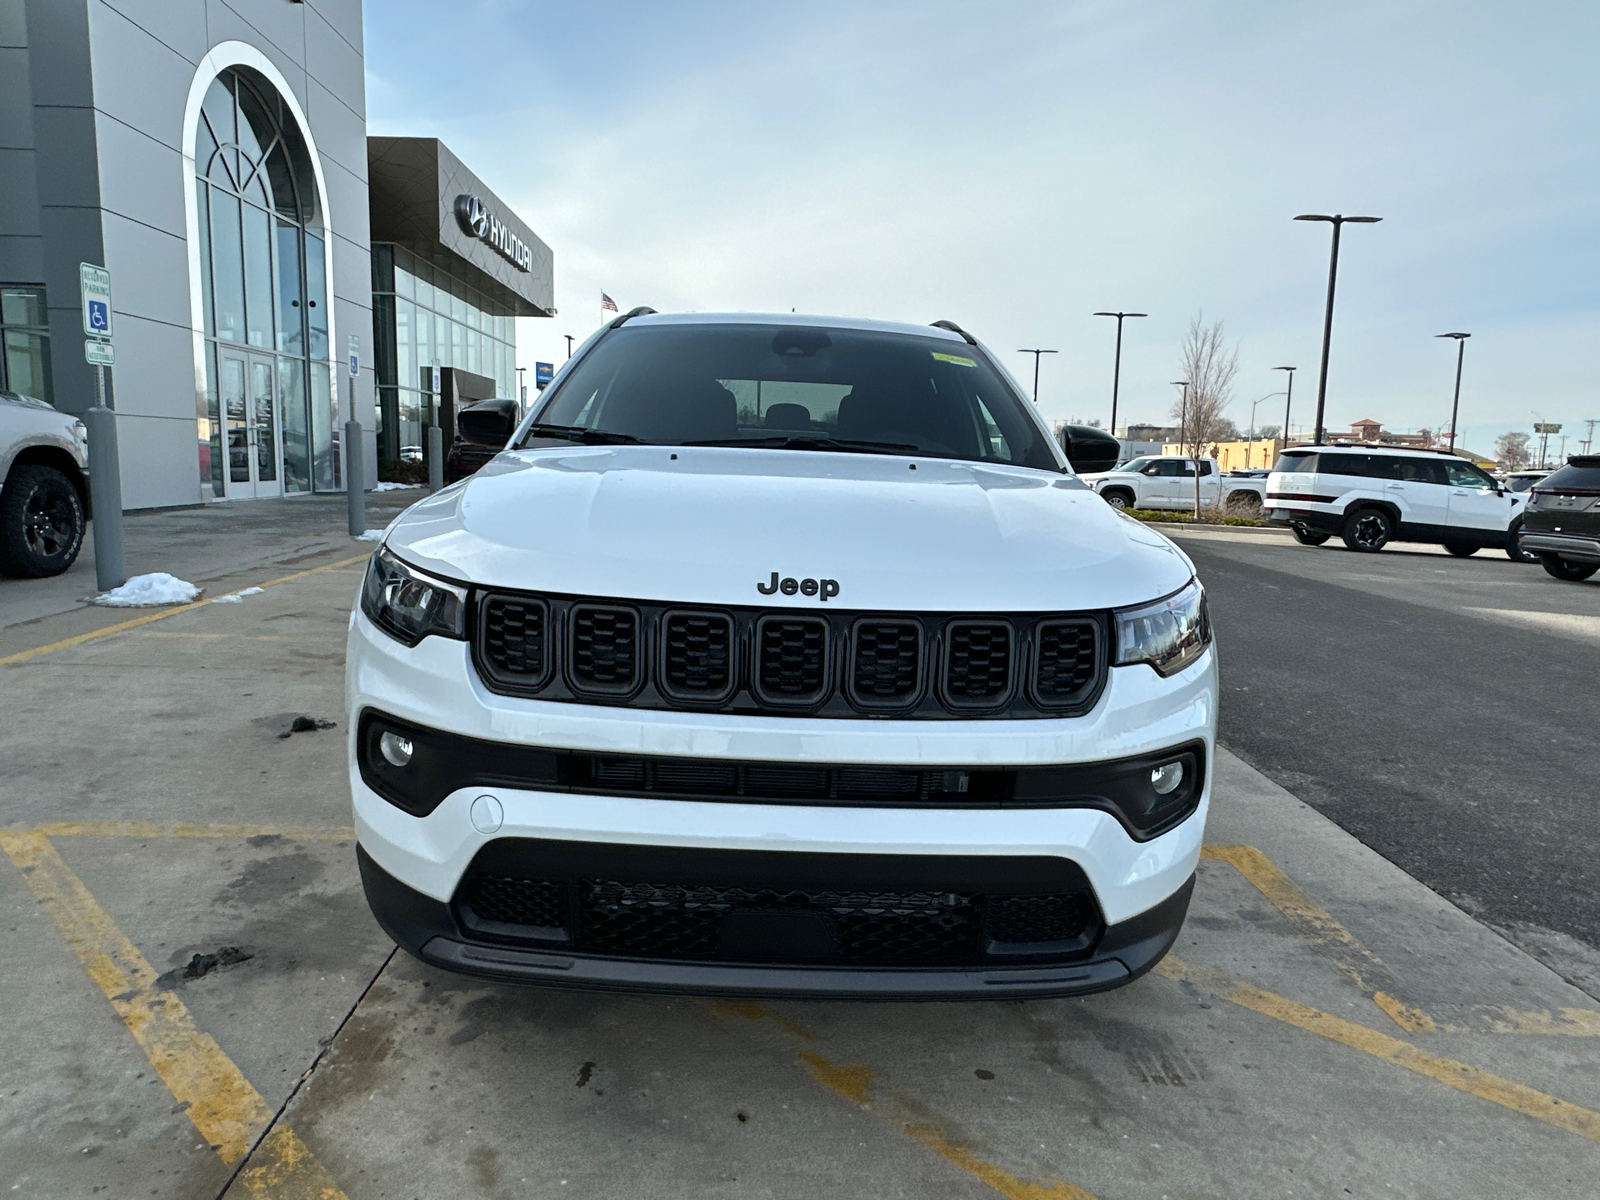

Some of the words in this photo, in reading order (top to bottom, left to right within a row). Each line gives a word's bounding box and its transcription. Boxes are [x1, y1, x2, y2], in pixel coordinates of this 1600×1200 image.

[490, 214, 532, 273] HYUNDAI
[84, 270, 109, 285] RESERVED
[84, 282, 109, 296] PARKING
[757, 572, 840, 601] Jeep
